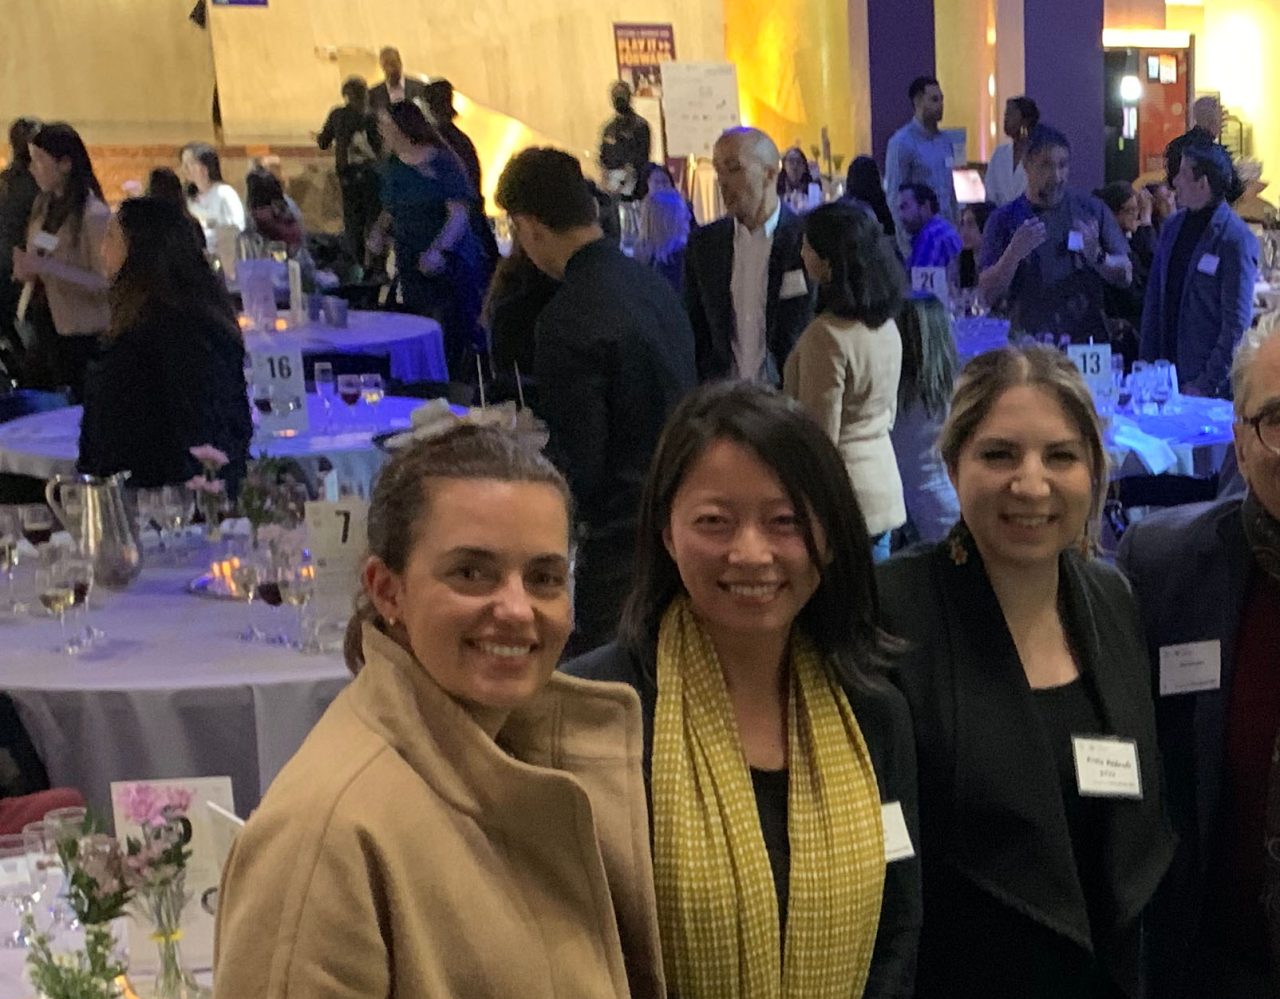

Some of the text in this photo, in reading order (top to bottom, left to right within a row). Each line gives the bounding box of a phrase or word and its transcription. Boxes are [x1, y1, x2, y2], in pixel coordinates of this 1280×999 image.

[267, 355, 292, 379] 16
[1080, 352, 1101, 375] 13
[335, 509, 351, 544] 7
